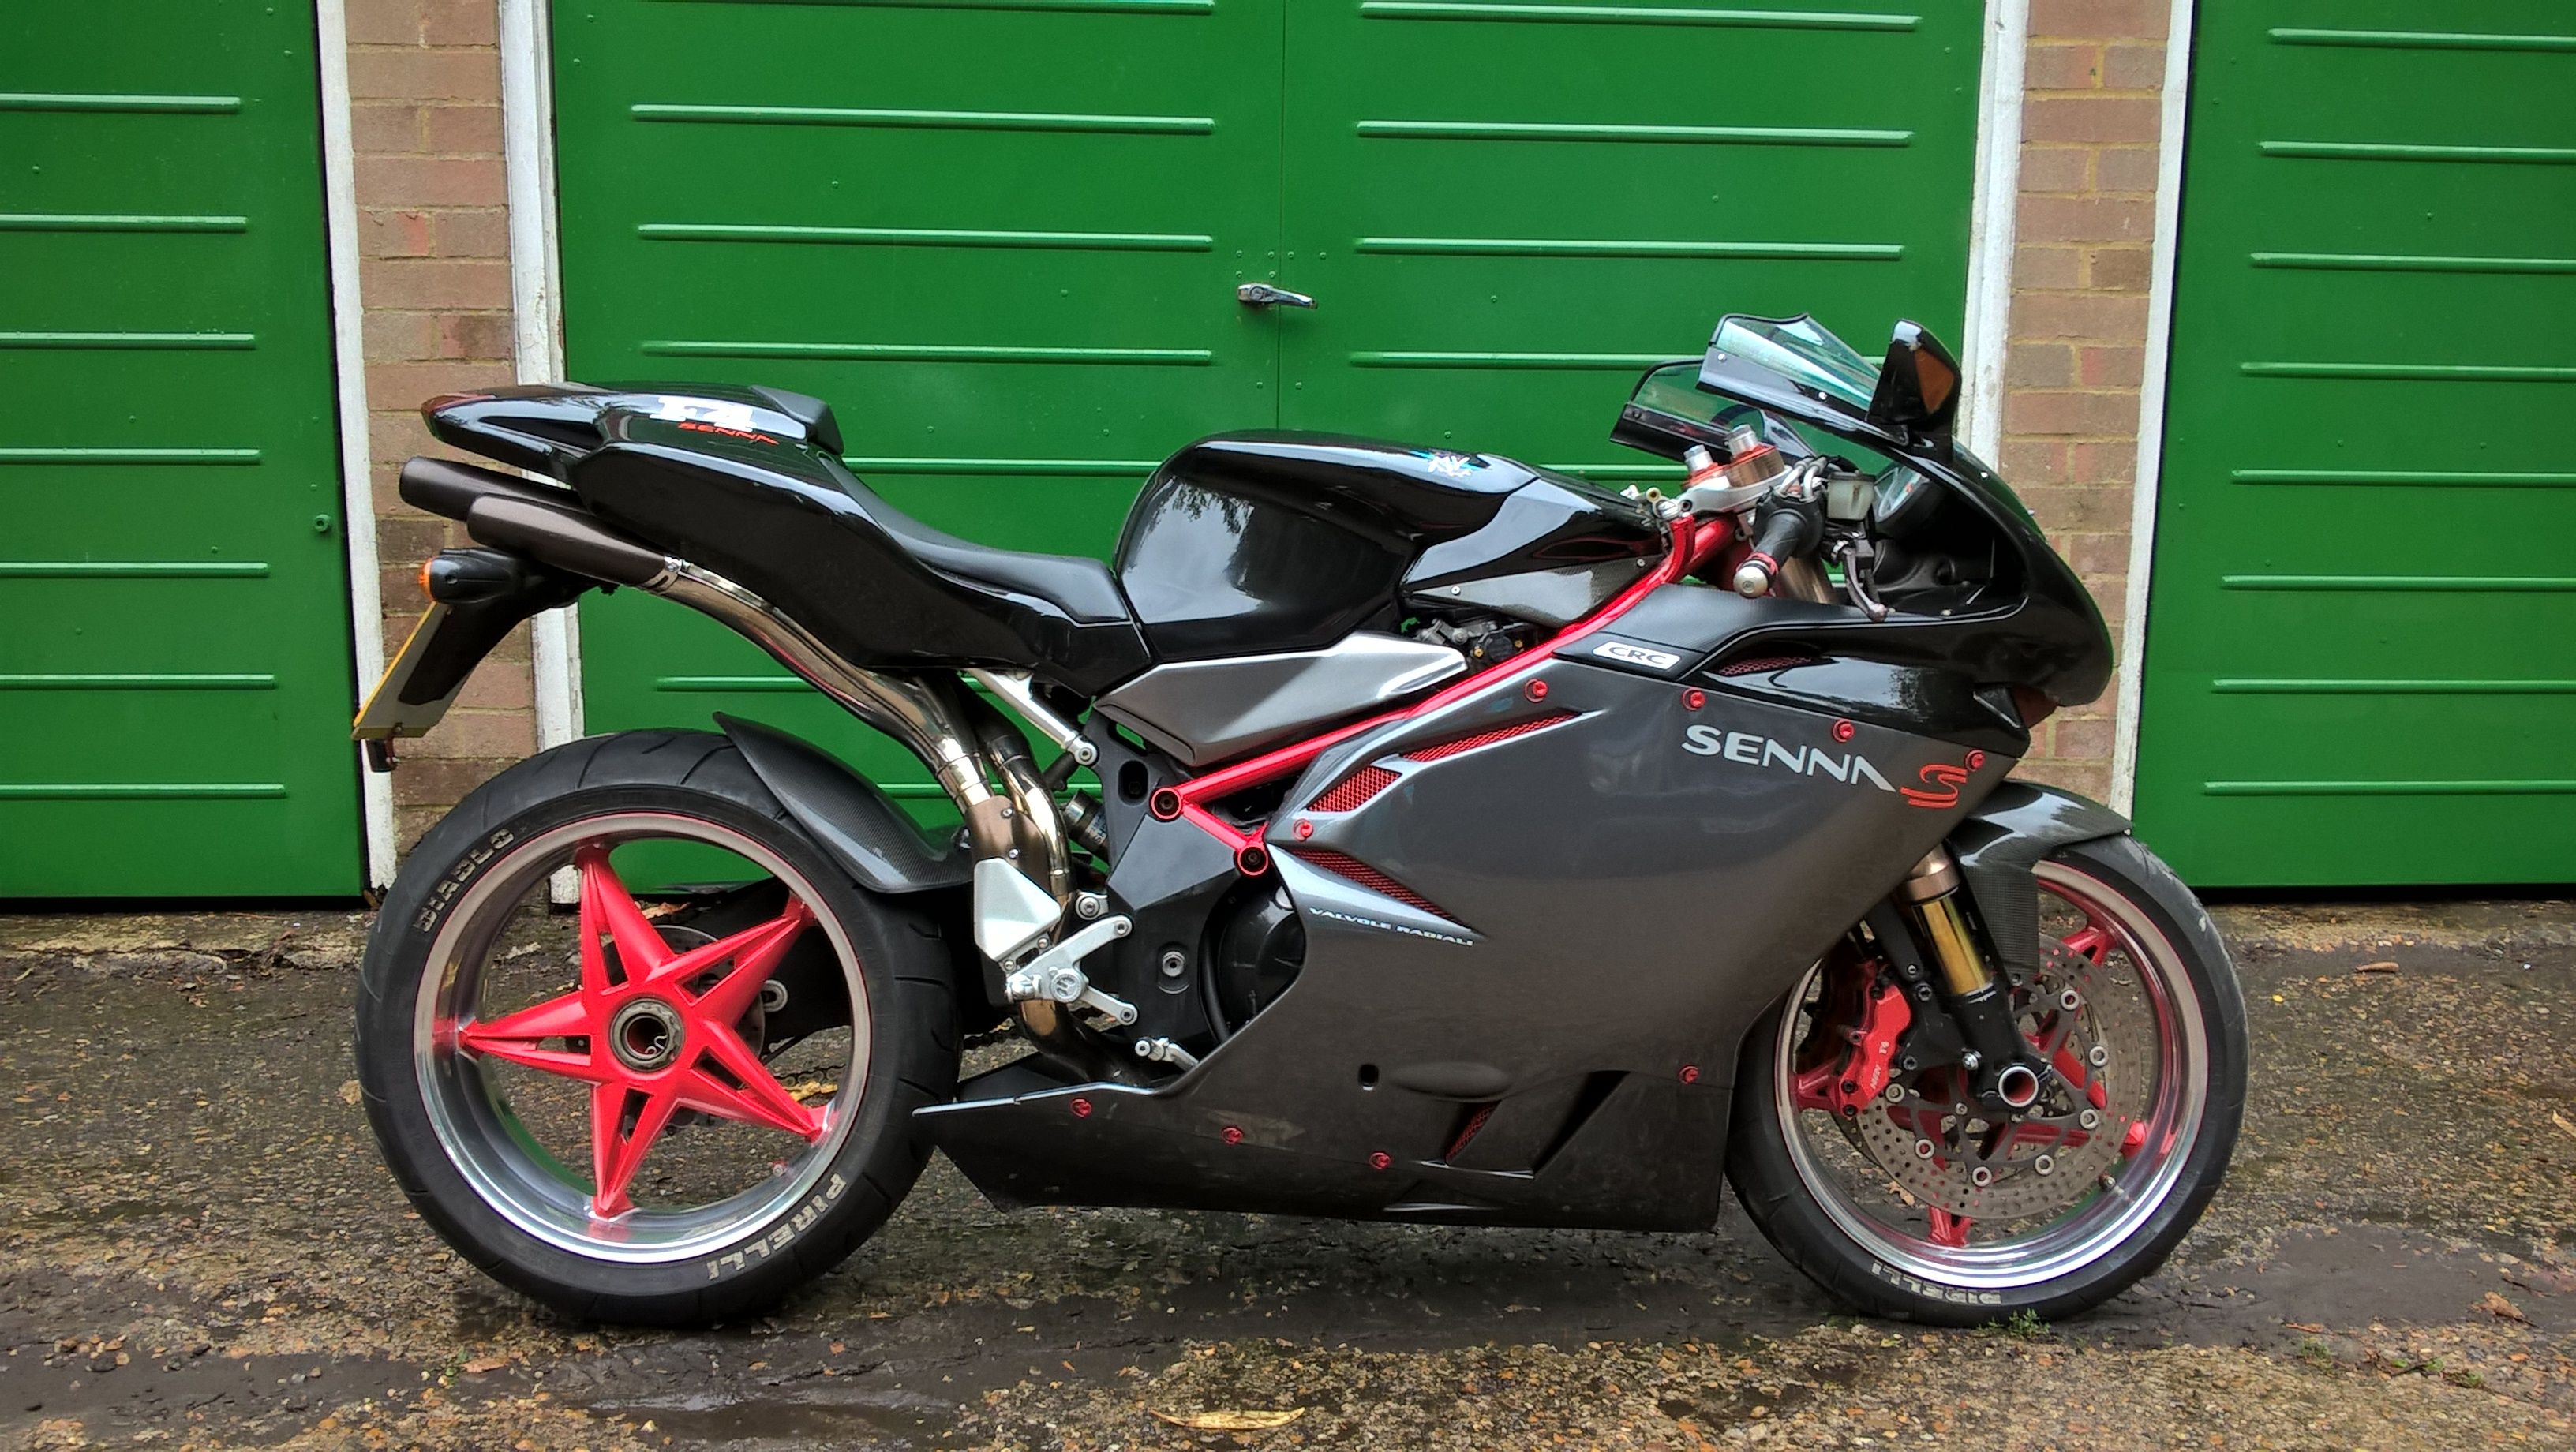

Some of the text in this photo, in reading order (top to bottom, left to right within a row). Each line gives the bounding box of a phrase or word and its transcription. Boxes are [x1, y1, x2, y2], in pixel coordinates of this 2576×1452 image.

[650, 396, 757, 432] F4
[678, 421, 780, 445] SENNA
[1608, 646, 1667, 664] CRC
[1681, 724, 1968, 809] SENNA S
[413, 829, 515, 933] DIABLO
[1309, 908, 1473, 947] VALVOLE RADIALI
[707, 1173, 847, 1280] PIRELLI
[1871, 1260, 2002, 1304] PIRELLI
